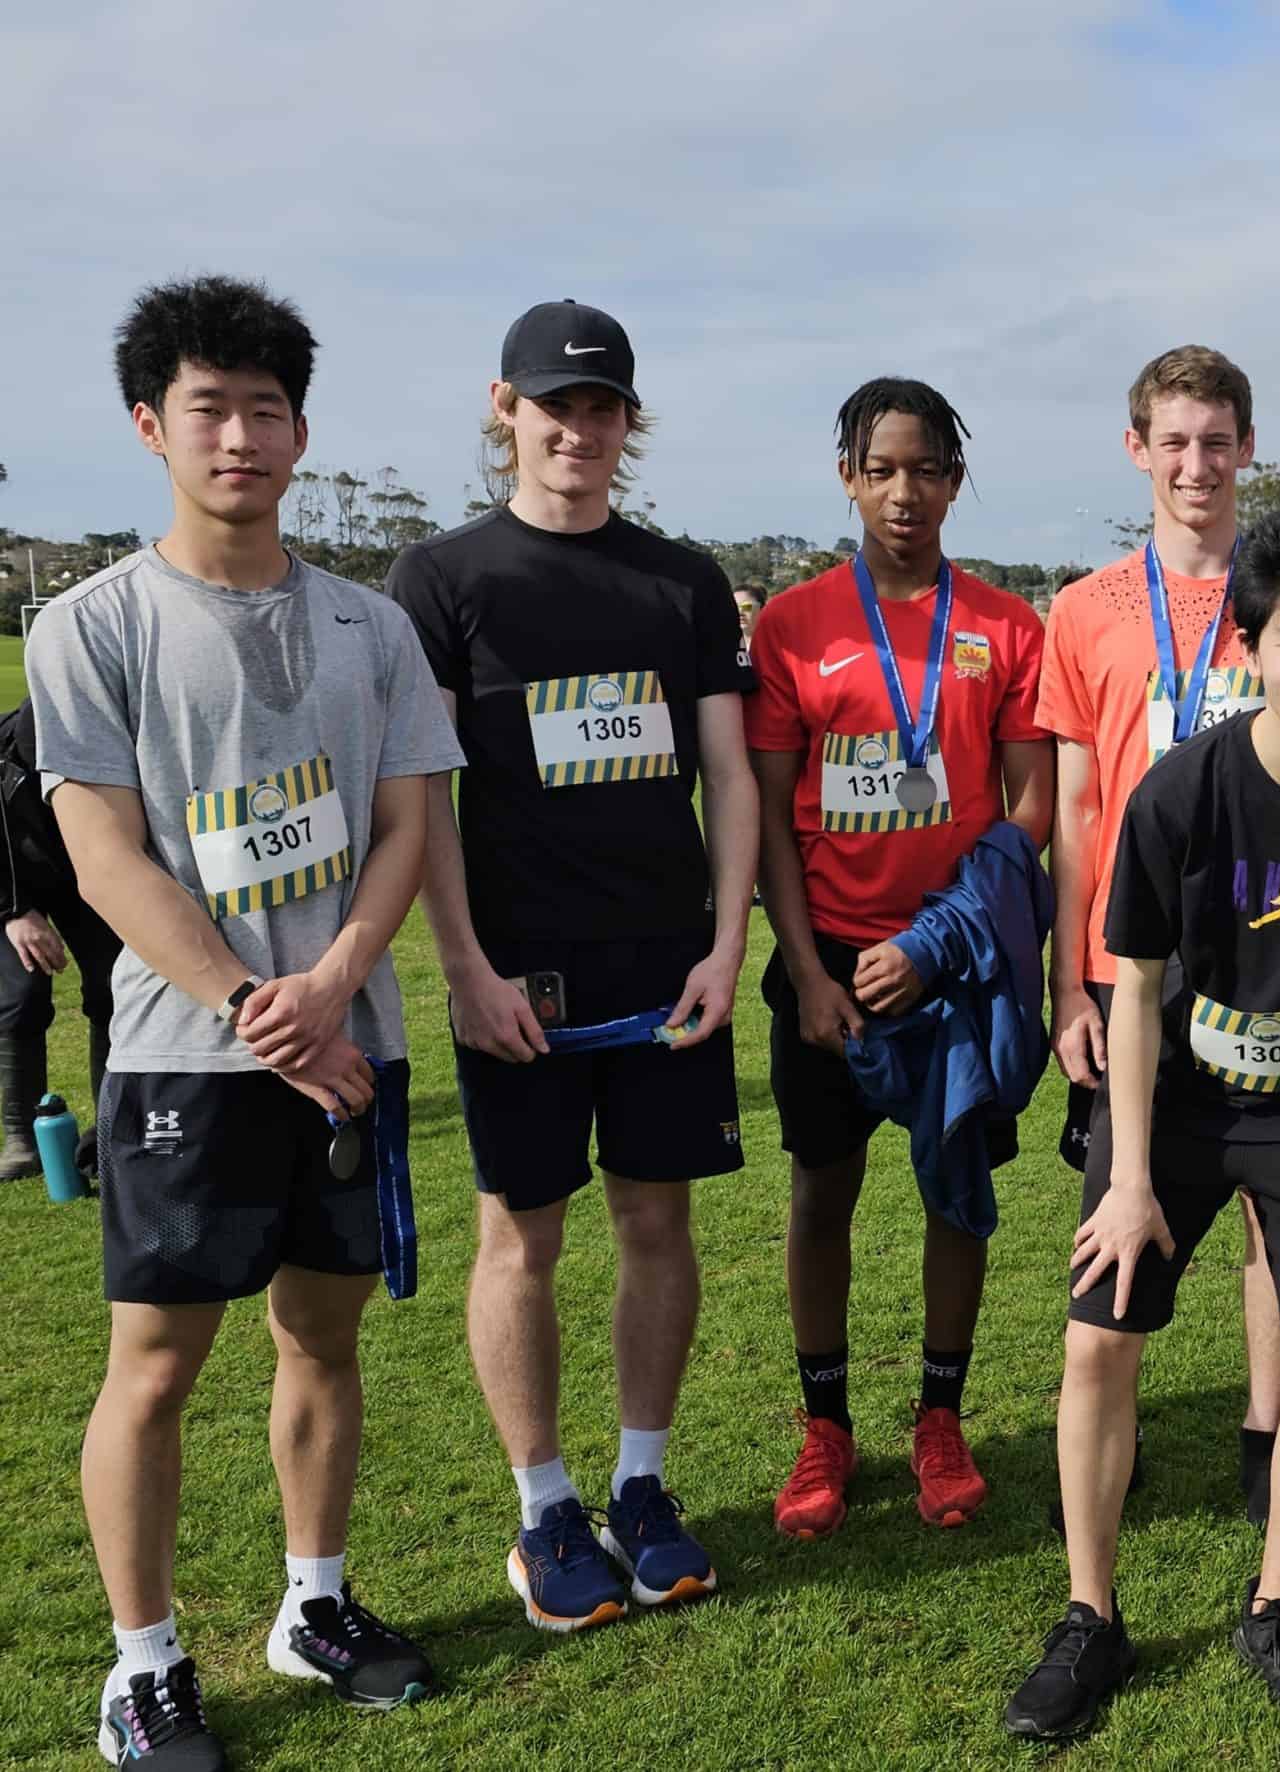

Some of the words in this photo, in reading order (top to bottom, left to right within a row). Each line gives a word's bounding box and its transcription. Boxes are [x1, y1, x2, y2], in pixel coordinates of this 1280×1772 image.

[577, 716, 642, 742] 1305
[1202, 708, 1242, 729] 31
[848, 771, 905, 797] 131
[244, 816, 313, 862] 1307
[805, 1361, 845, 1382] VAN
